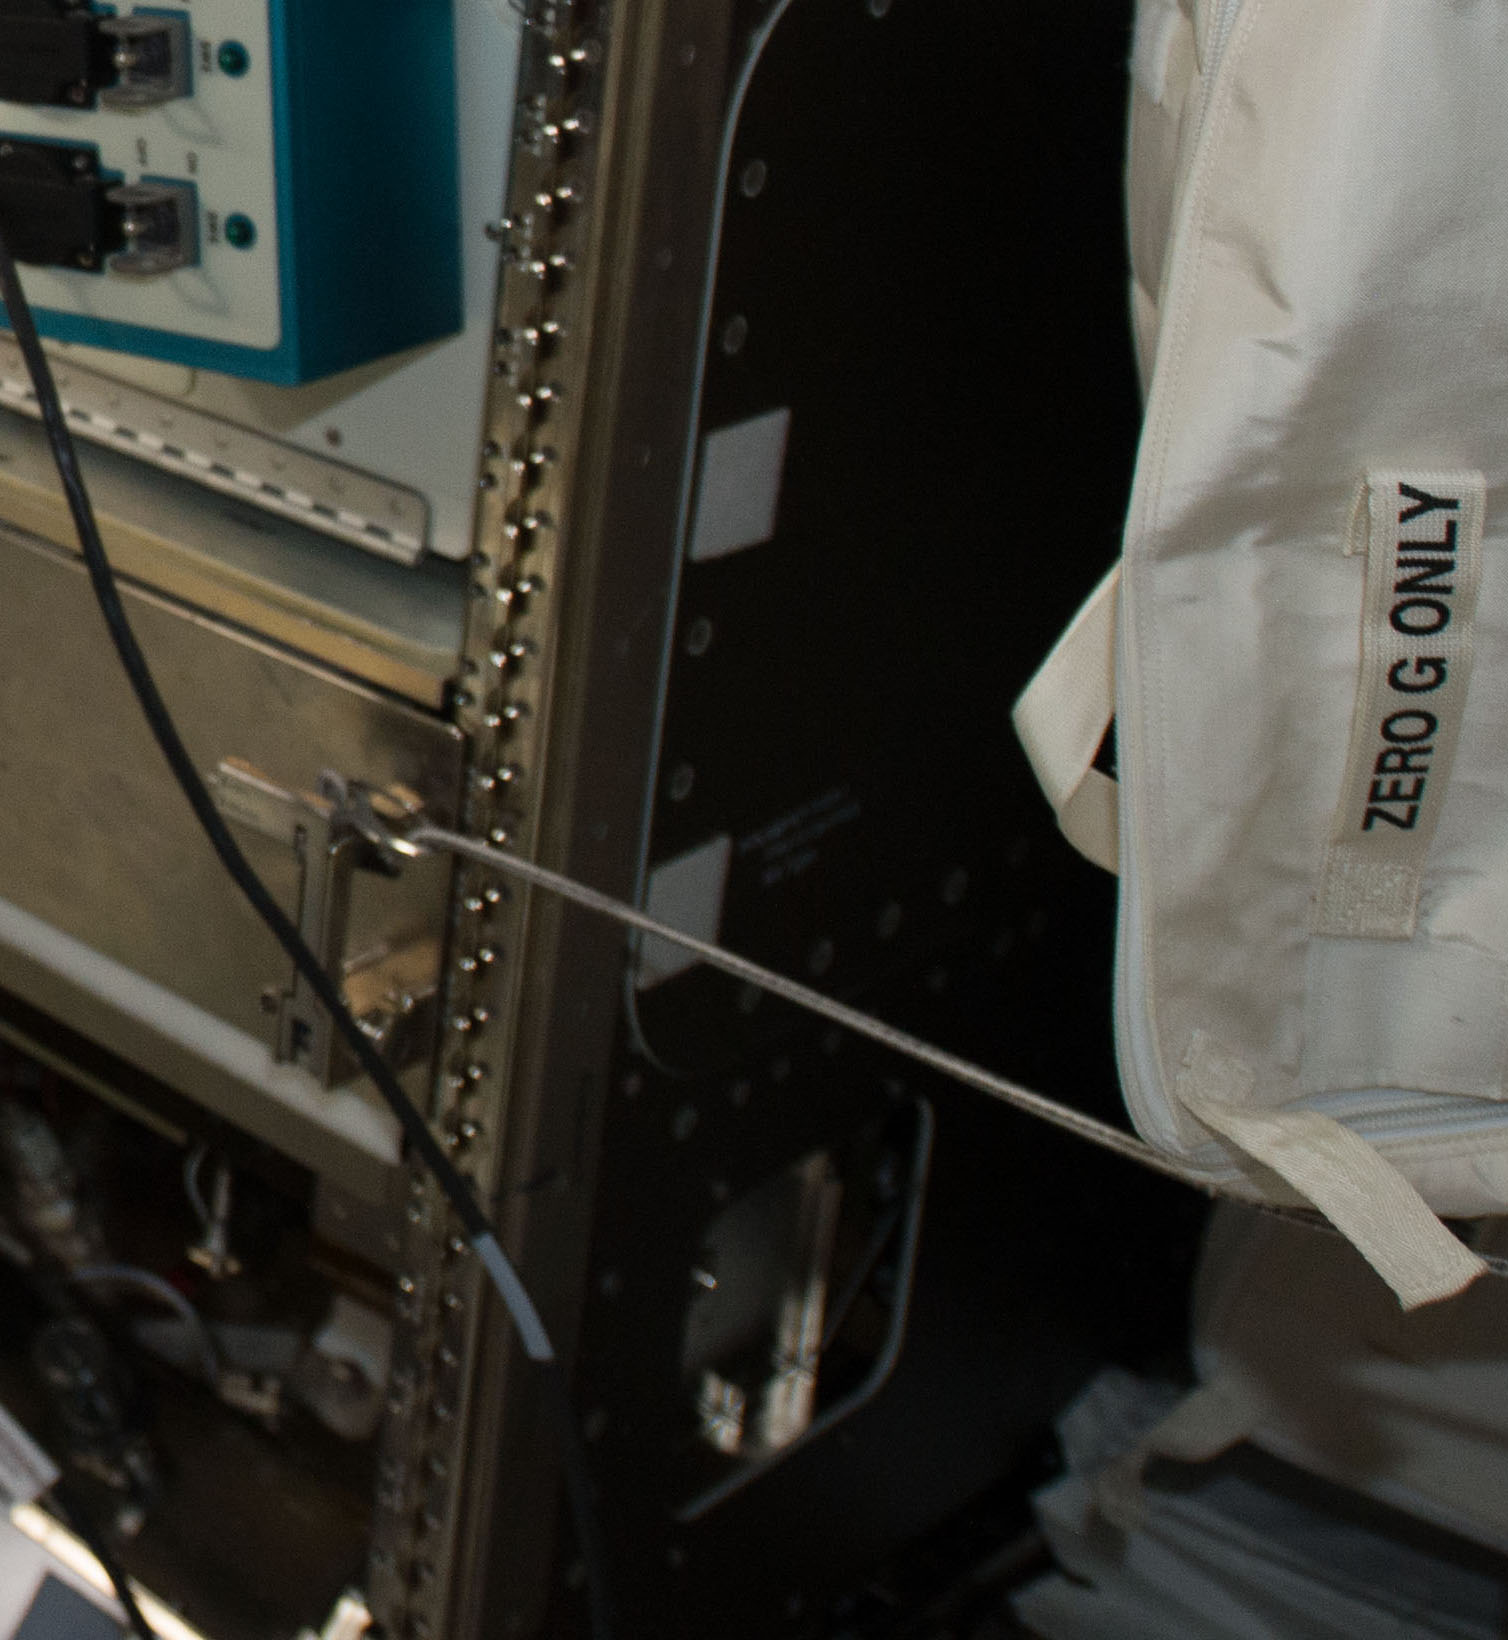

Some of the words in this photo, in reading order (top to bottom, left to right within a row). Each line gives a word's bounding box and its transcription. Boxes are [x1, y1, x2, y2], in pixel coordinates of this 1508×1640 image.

[1388, 481, 1461, 636] ONLY
[1387, 656, 1448, 693] G
[1361, 709, 1439, 831] ZERO
